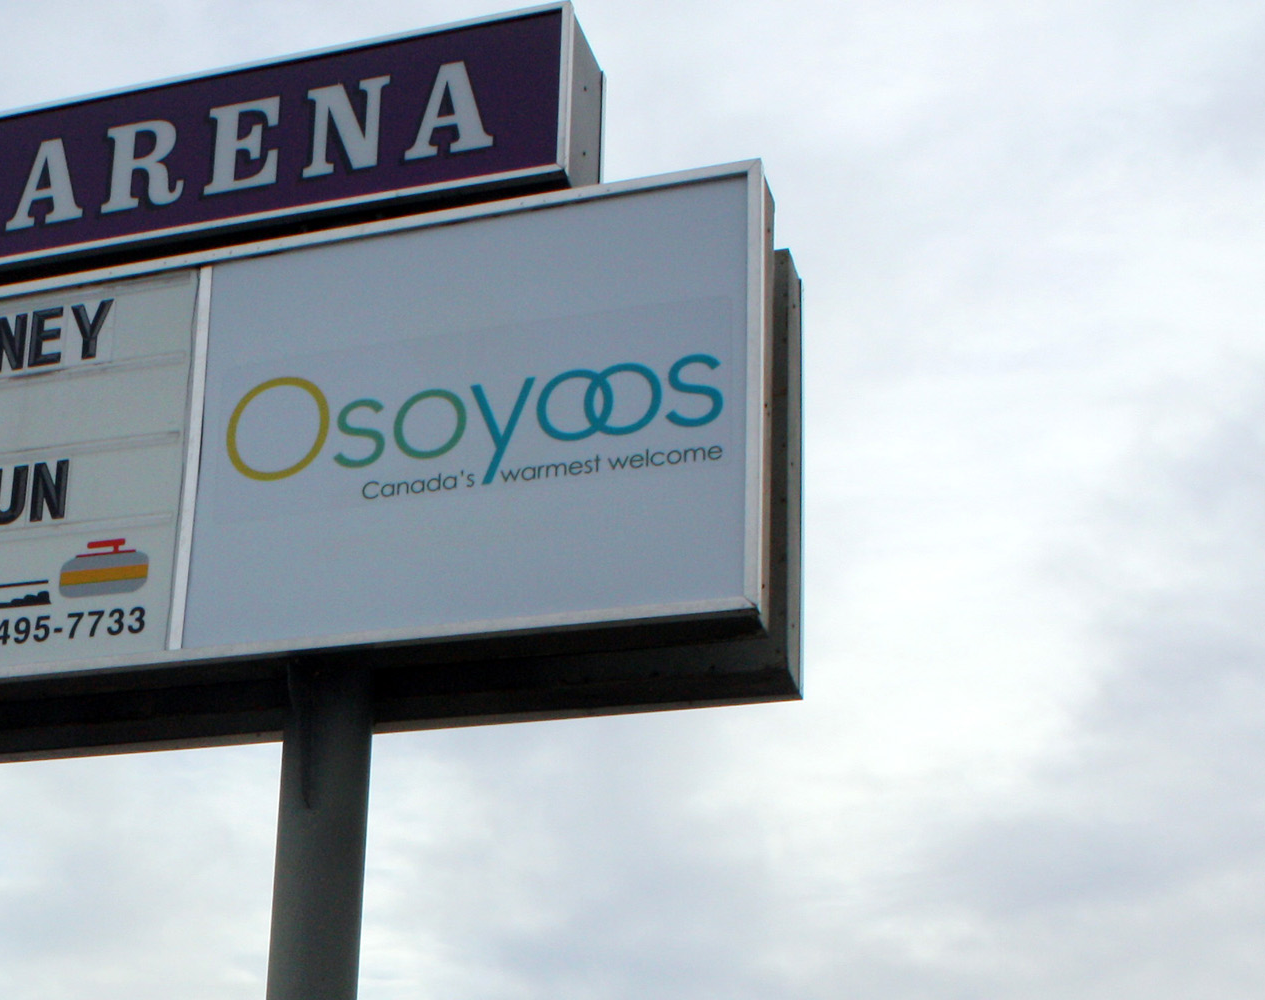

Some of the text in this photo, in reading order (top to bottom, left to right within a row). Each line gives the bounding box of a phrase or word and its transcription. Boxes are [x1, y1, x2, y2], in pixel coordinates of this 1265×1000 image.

[5, 61, 494, 232] ARENA
[226, 353, 724, 485] Osoyoos
[361, 443, 723, 500] Canada's warmest welcome
